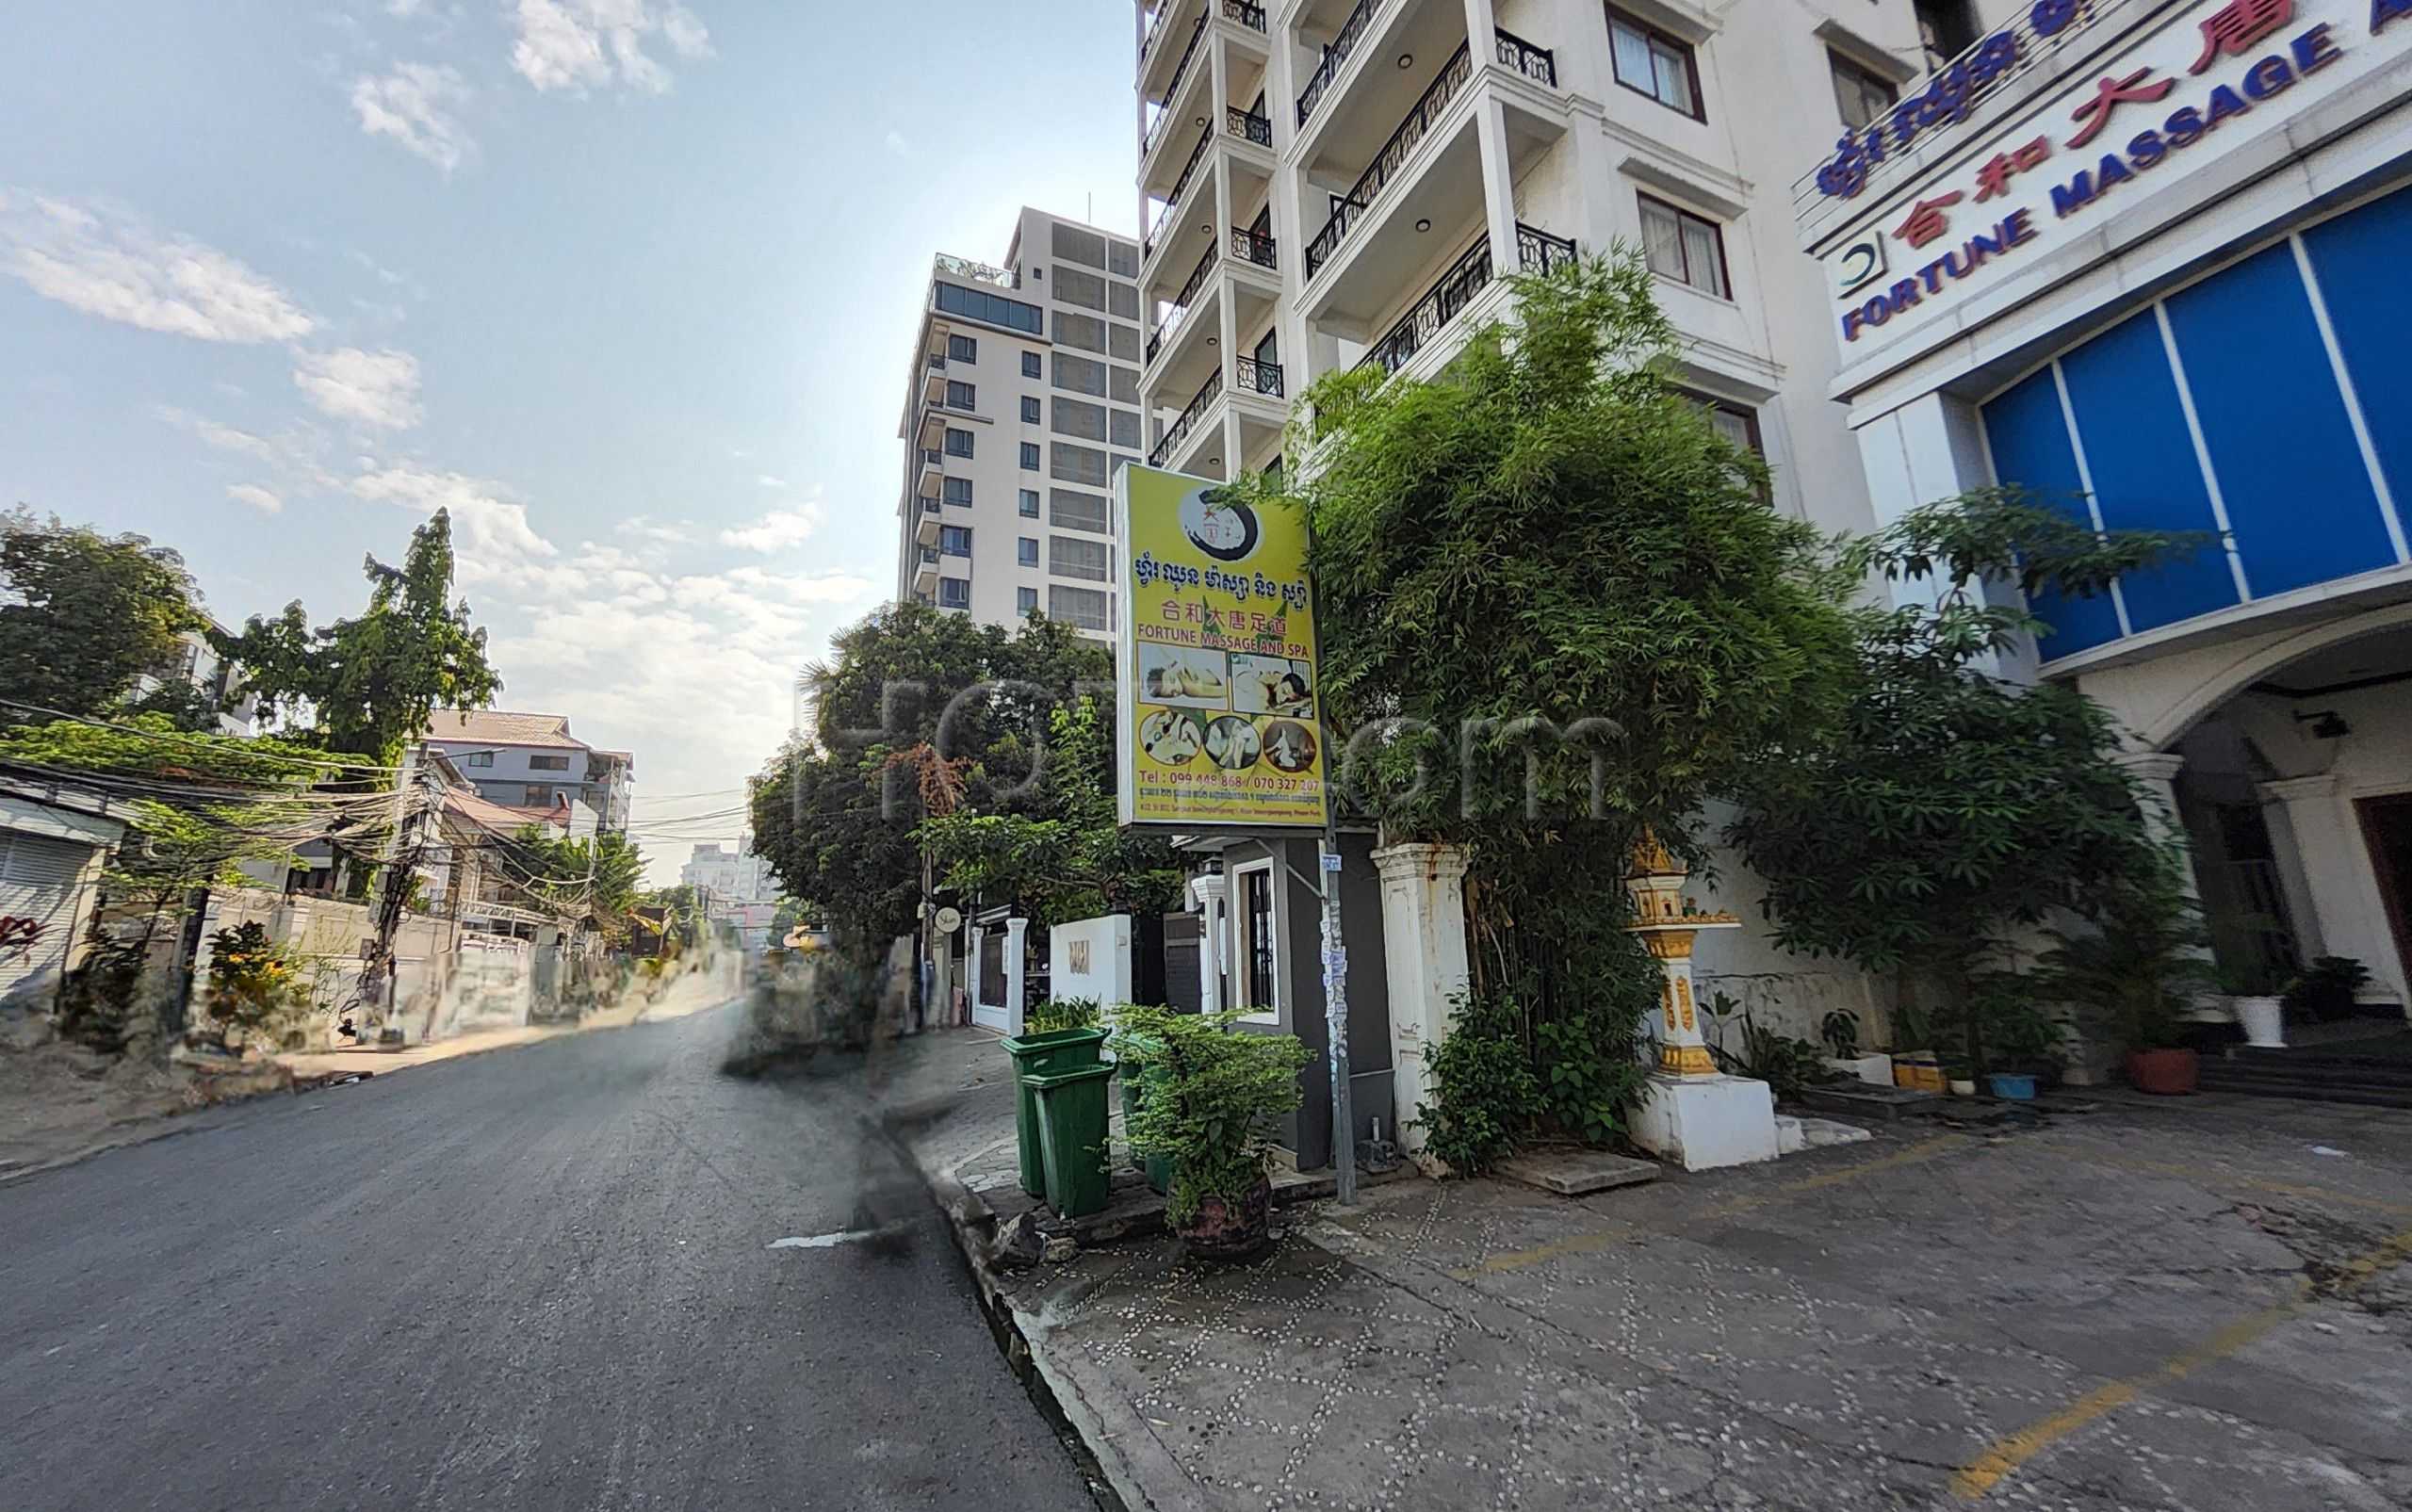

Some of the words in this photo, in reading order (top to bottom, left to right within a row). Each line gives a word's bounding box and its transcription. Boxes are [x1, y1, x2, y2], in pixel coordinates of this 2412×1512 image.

[1841, 207, 2038, 341] FORTUNE
[2048, 22, 2343, 219] MASSAGE
[1162, 599, 1287, 636] 合和大唐足道
[1137, 624, 1196, 643] FORTUNE
[1201, 632, 1256, 651] MASSAGE
[1261, 640, 1285, 655] AND
[1288, 643, 1309, 658] SPA
[1139, 770, 1158, 783] Tel
[1170, 772, 1192, 784] 099
[1221, 775, 1242, 788] 868
[1254, 777, 1274, 789] 070
[1278, 778, 1296, 790] 327
[1300, 780, 1319, 791] 207
